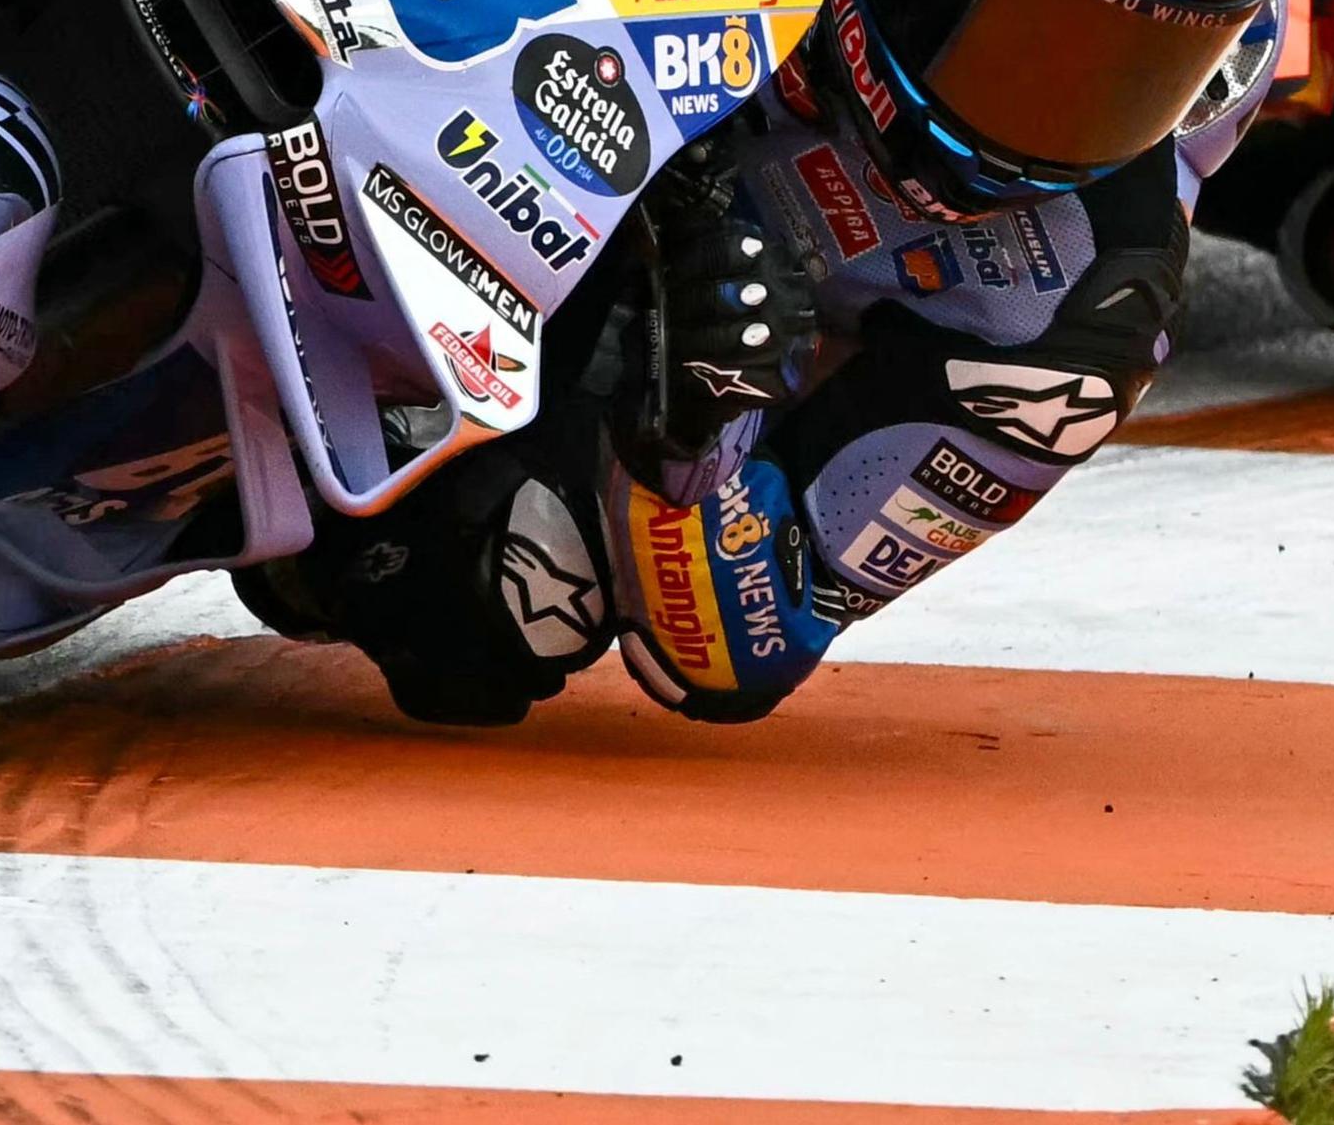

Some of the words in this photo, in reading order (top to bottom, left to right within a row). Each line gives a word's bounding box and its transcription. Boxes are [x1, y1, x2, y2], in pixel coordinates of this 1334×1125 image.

[1152, 2, 1229, 29] WINGS
[654, 26, 754, 92] BK8
[533, 79, 618, 175] Galicia
[545, 50, 635, 153] Estrella
[671, 93, 719, 116] NEWS
[268, 133, 312, 245] RIDERS
[281, 121, 343, 246] BOLD
[436, 110, 593, 272] Unibat
[816, 165, 870, 243] ASPIRA
[433, 324, 488, 383] FEDERAL
[487, 379, 514, 405] OIL
[920, 467, 992, 517] RIDERS
[930, 447, 1008, 505] BOLD
[938, 520, 982, 541] AUS
[646, 498, 710, 671] Antangin
[733, 560, 787, 660] NEWS
